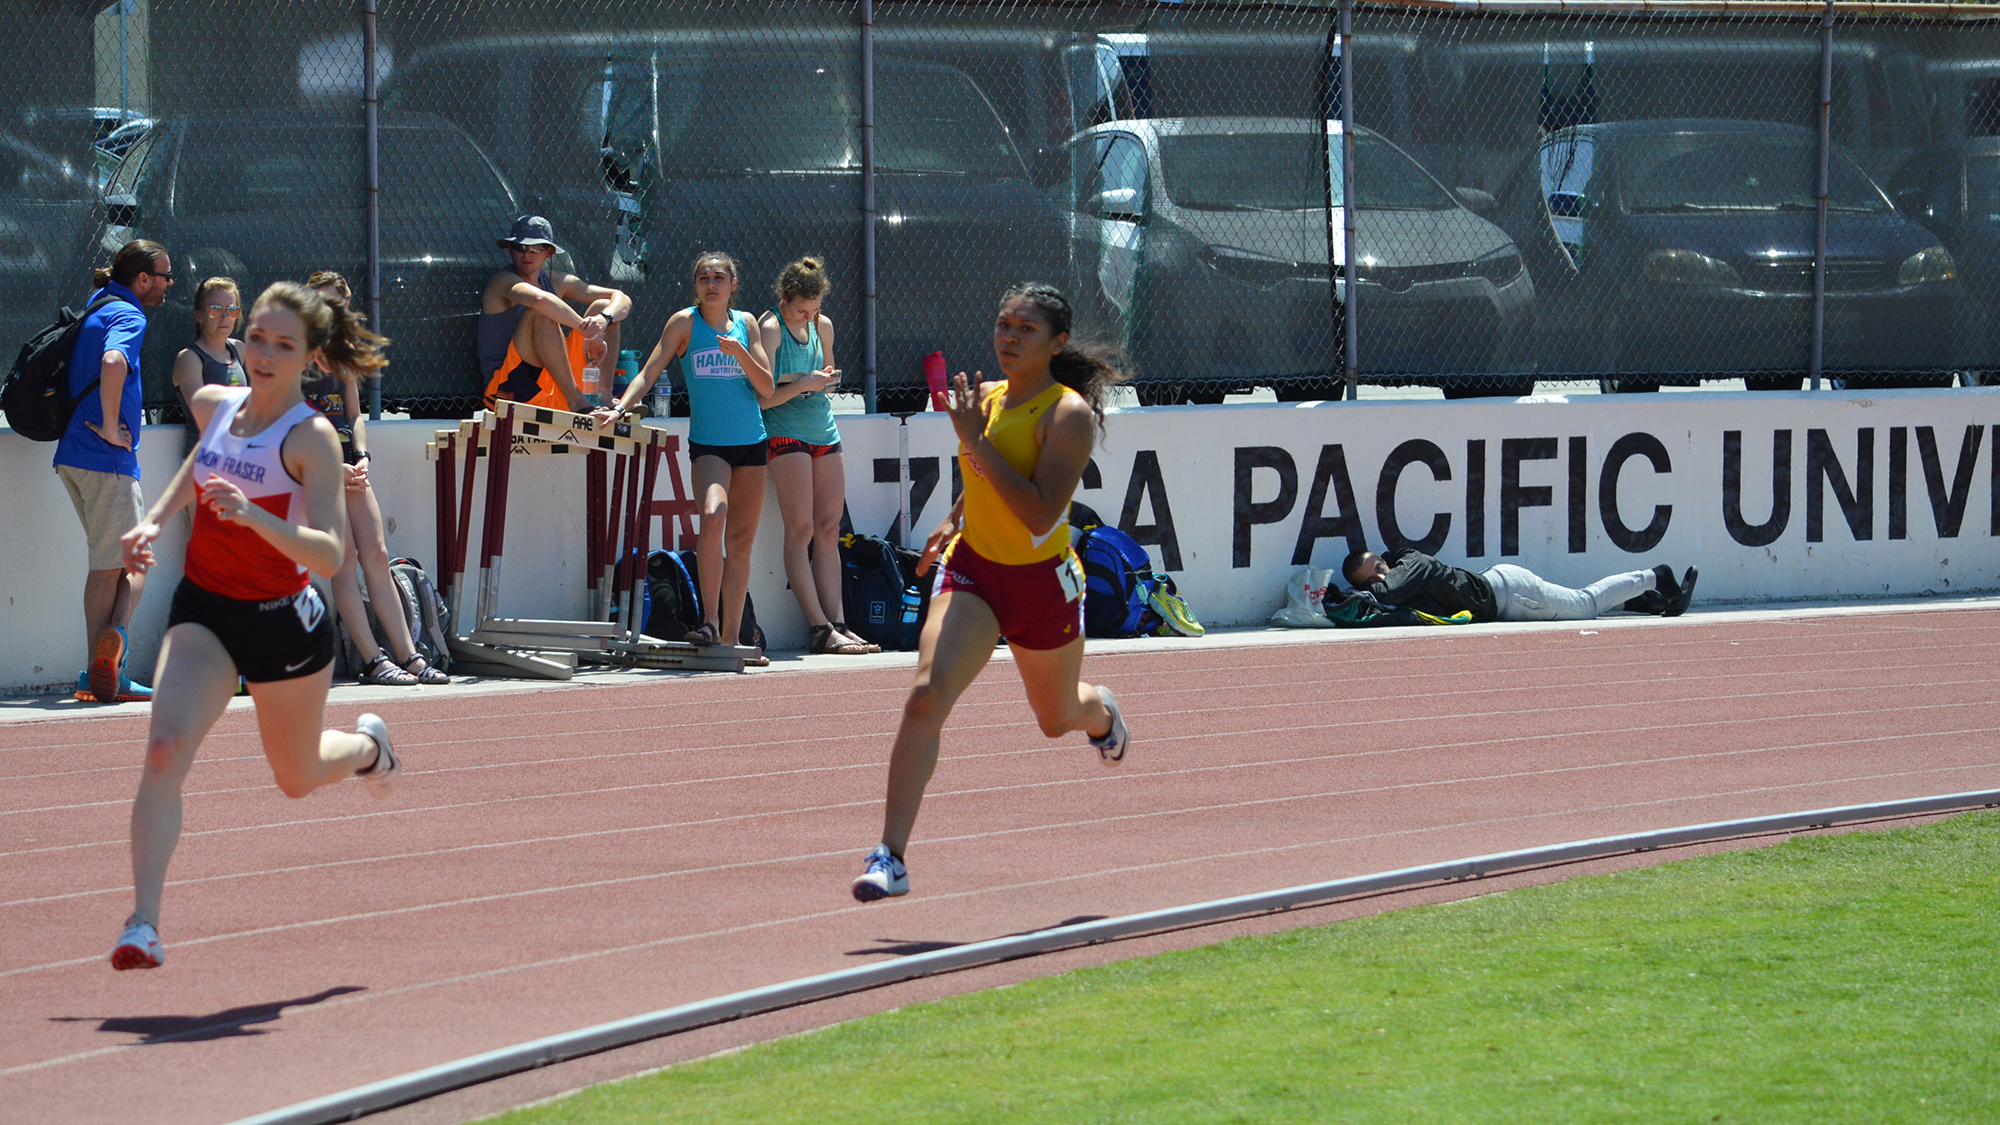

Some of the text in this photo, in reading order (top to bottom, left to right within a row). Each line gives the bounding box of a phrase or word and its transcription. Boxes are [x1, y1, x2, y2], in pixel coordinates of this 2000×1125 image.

[696, 353, 741, 369] HAMM
[710, 367, 743, 375] NUTRITON
[196, 446, 267, 484] MON FRASER
[1232, 431, 1673, 569] PACIFIC
[1722, 424, 2000, 547] UNIV
[259, 596, 291, 611] NIKE
